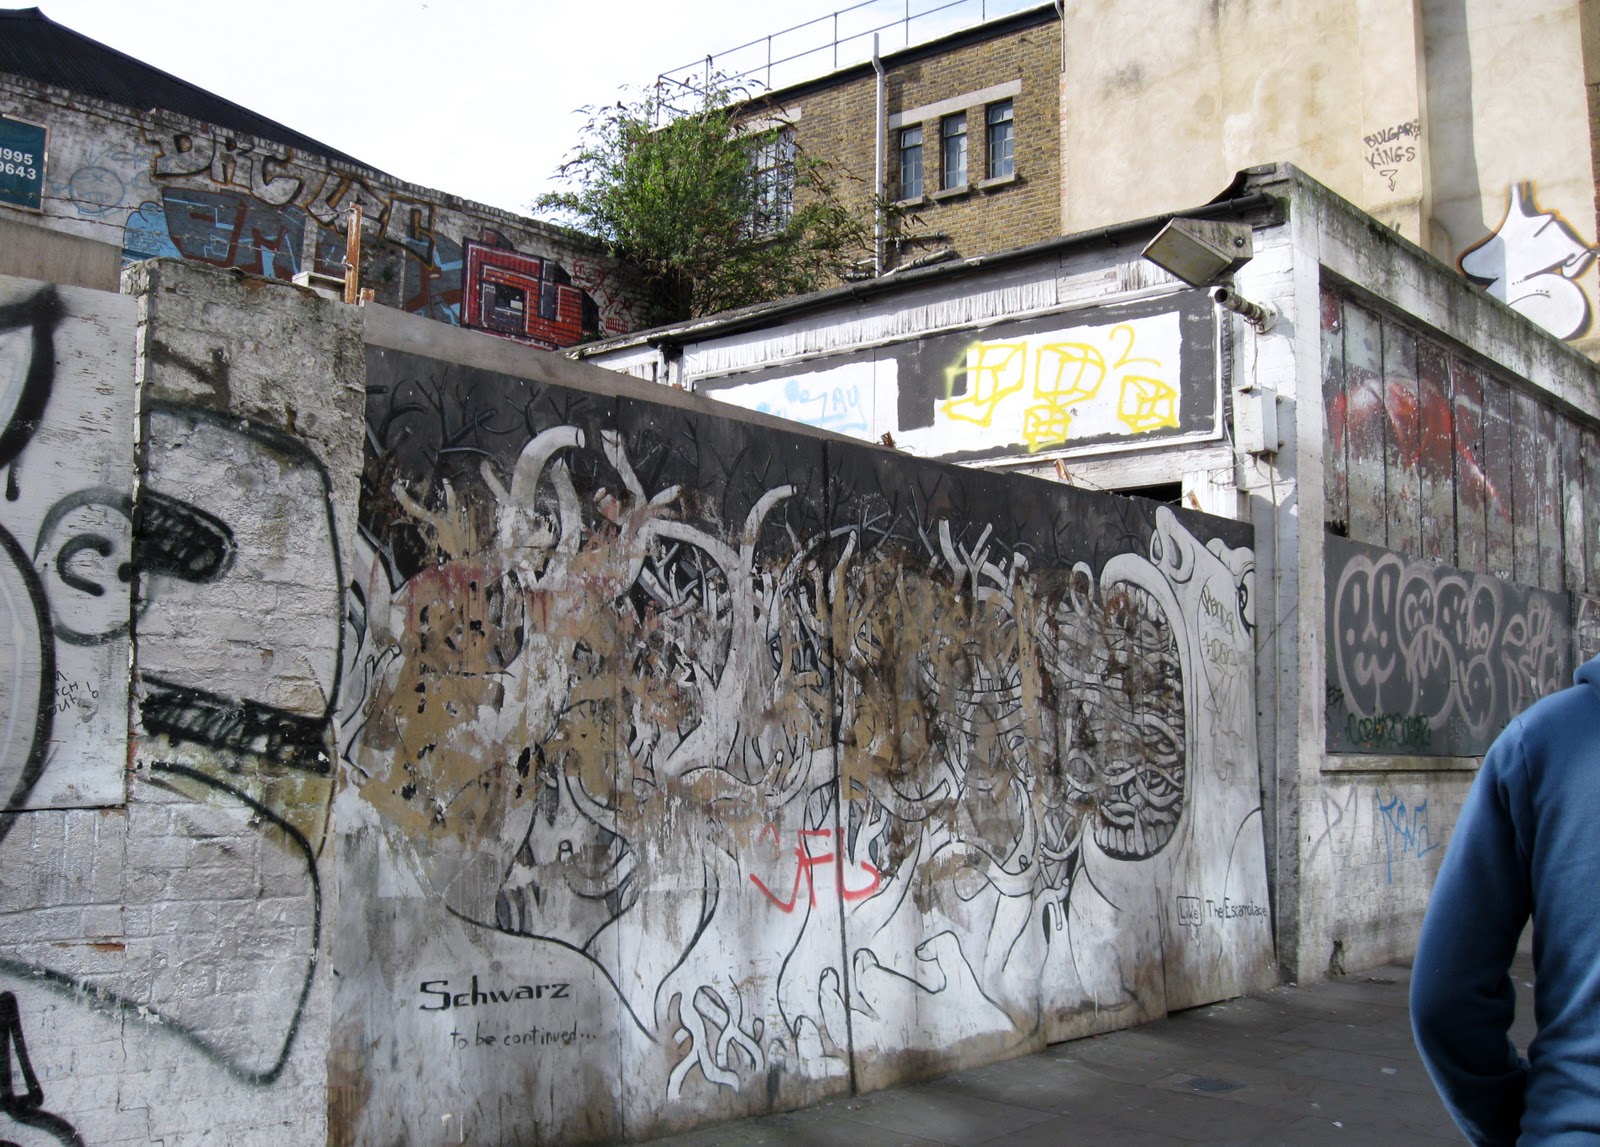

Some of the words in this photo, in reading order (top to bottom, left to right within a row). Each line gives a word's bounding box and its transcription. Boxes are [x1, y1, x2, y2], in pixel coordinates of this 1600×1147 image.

[419, 975, 571, 1012] Schwarz
[450, 1026, 468, 1049] to
[475, 1021, 497, 1047] be
